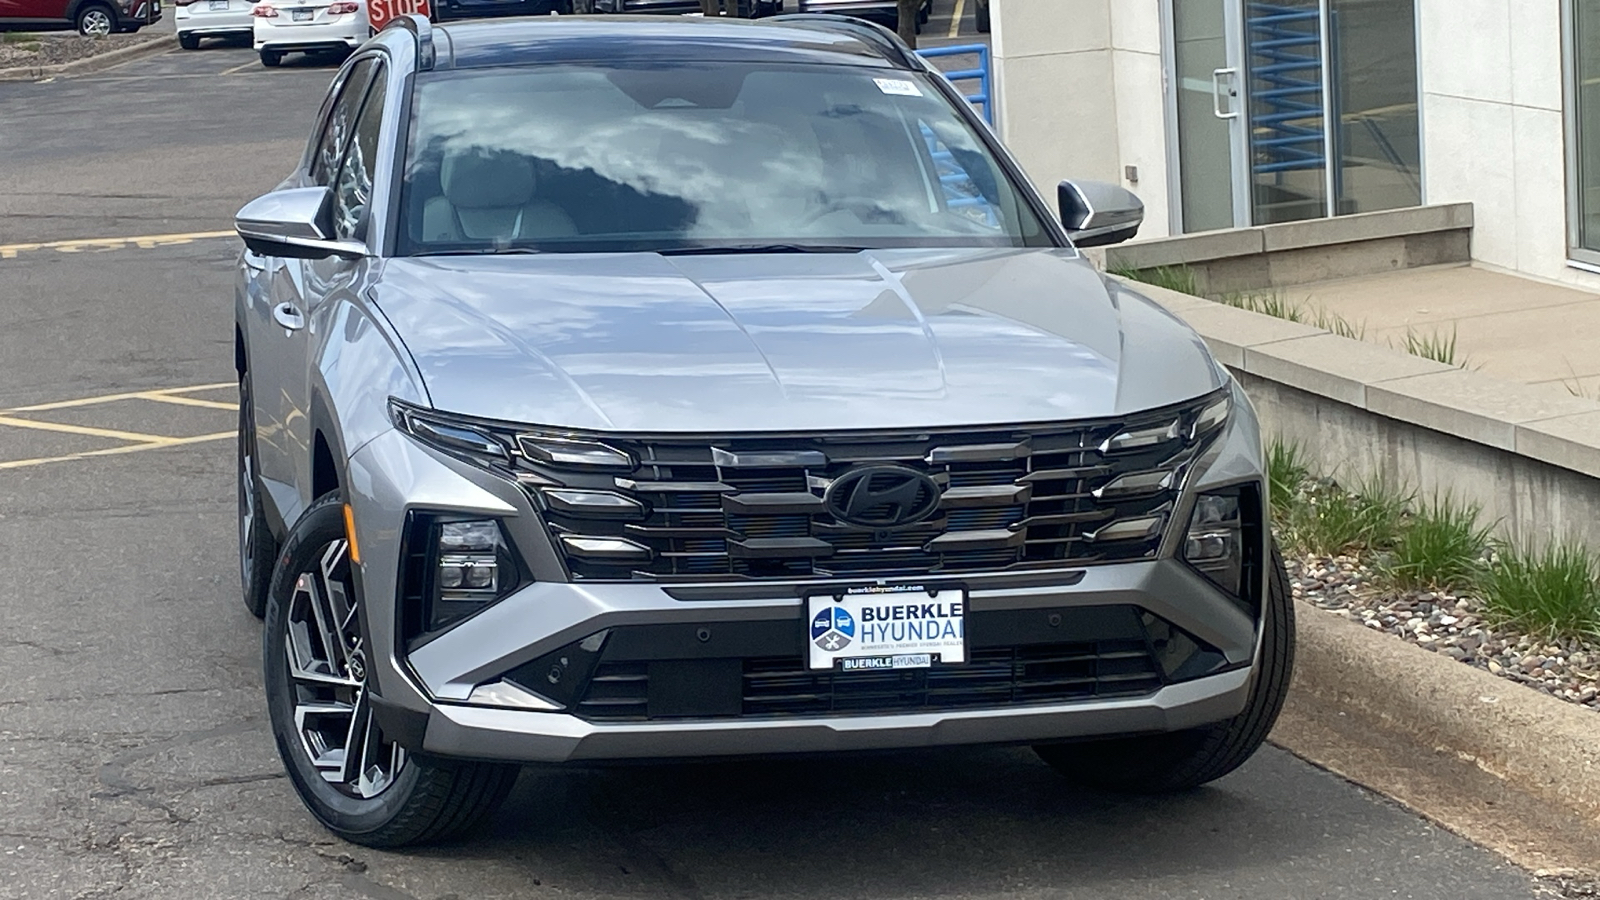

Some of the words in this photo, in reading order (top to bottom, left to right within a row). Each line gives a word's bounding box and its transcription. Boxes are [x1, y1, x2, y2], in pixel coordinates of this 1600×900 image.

[371, 0, 425, 21] STOP
[861, 603, 963, 622] BUERKLE
[861, 619, 963, 643] HYUNDAI
[844, 657, 892, 669] BUERKLE
[893, 655, 930, 666] HYUNDAI
